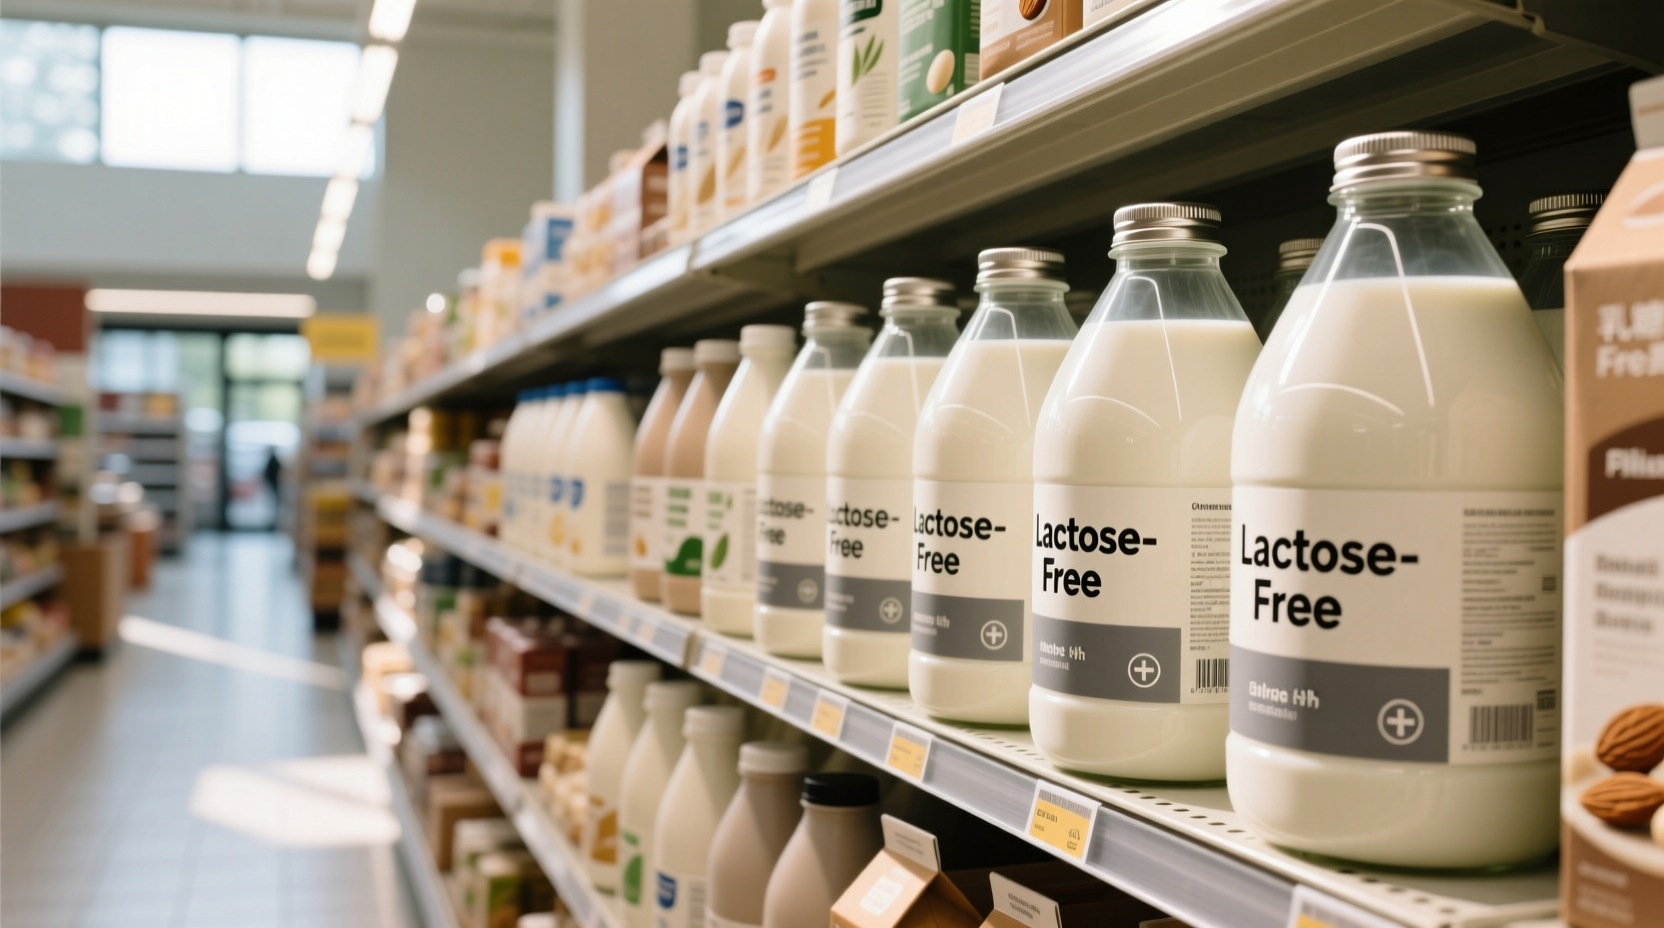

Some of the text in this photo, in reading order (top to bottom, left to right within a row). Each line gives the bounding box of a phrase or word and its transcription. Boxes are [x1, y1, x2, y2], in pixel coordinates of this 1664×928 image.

[827, 501, 899, 529] ctose-
[914, 507, 1006, 541] Lactose-
[1036, 514, 1157, 556] Lactose-
[917, 543, 960, 575] Free
[1241, 524, 1418, 576] Lactose-
[1043, 557, 1101, 598] Free
[1254, 579, 1342, 629] Free
